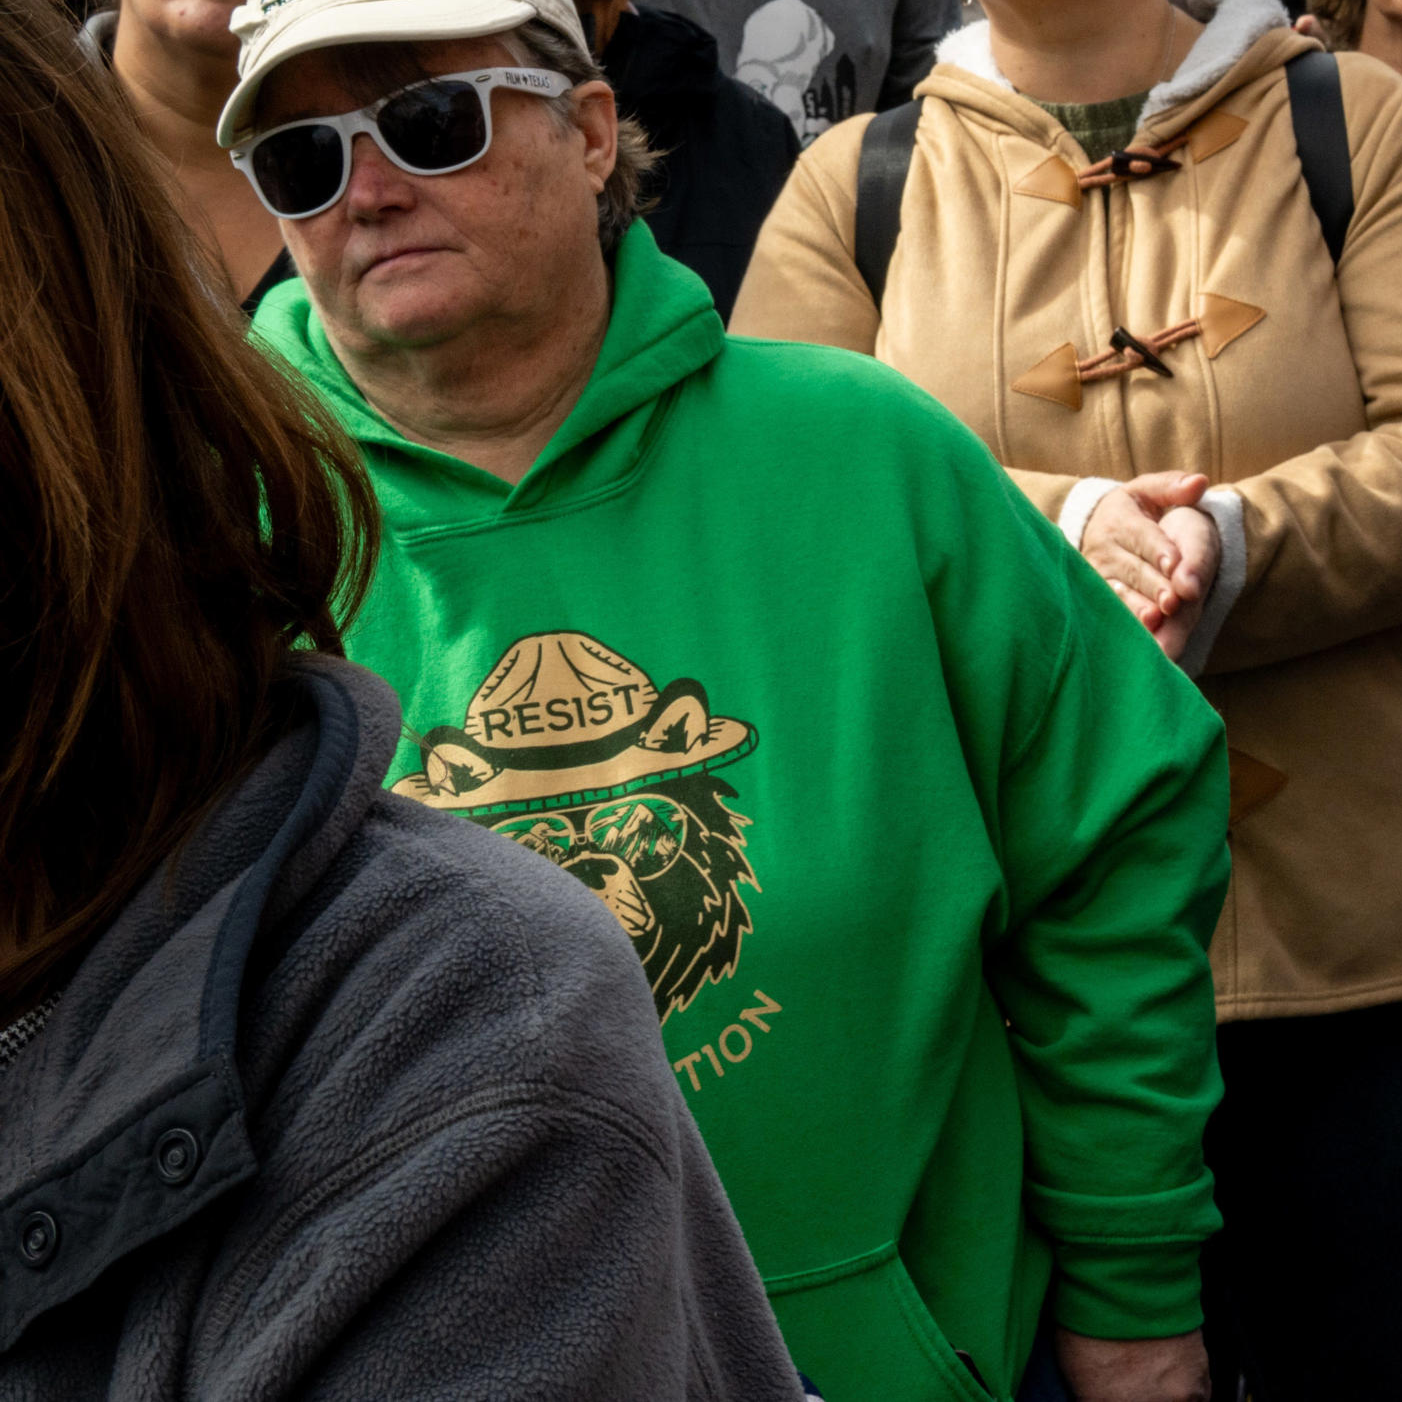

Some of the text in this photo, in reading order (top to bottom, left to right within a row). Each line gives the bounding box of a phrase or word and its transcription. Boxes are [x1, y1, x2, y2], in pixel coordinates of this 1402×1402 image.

[505, 71, 551, 89] FILM TEXAS
[478, 683, 643, 743] RESIST
[672, 989, 783, 1092] TION
